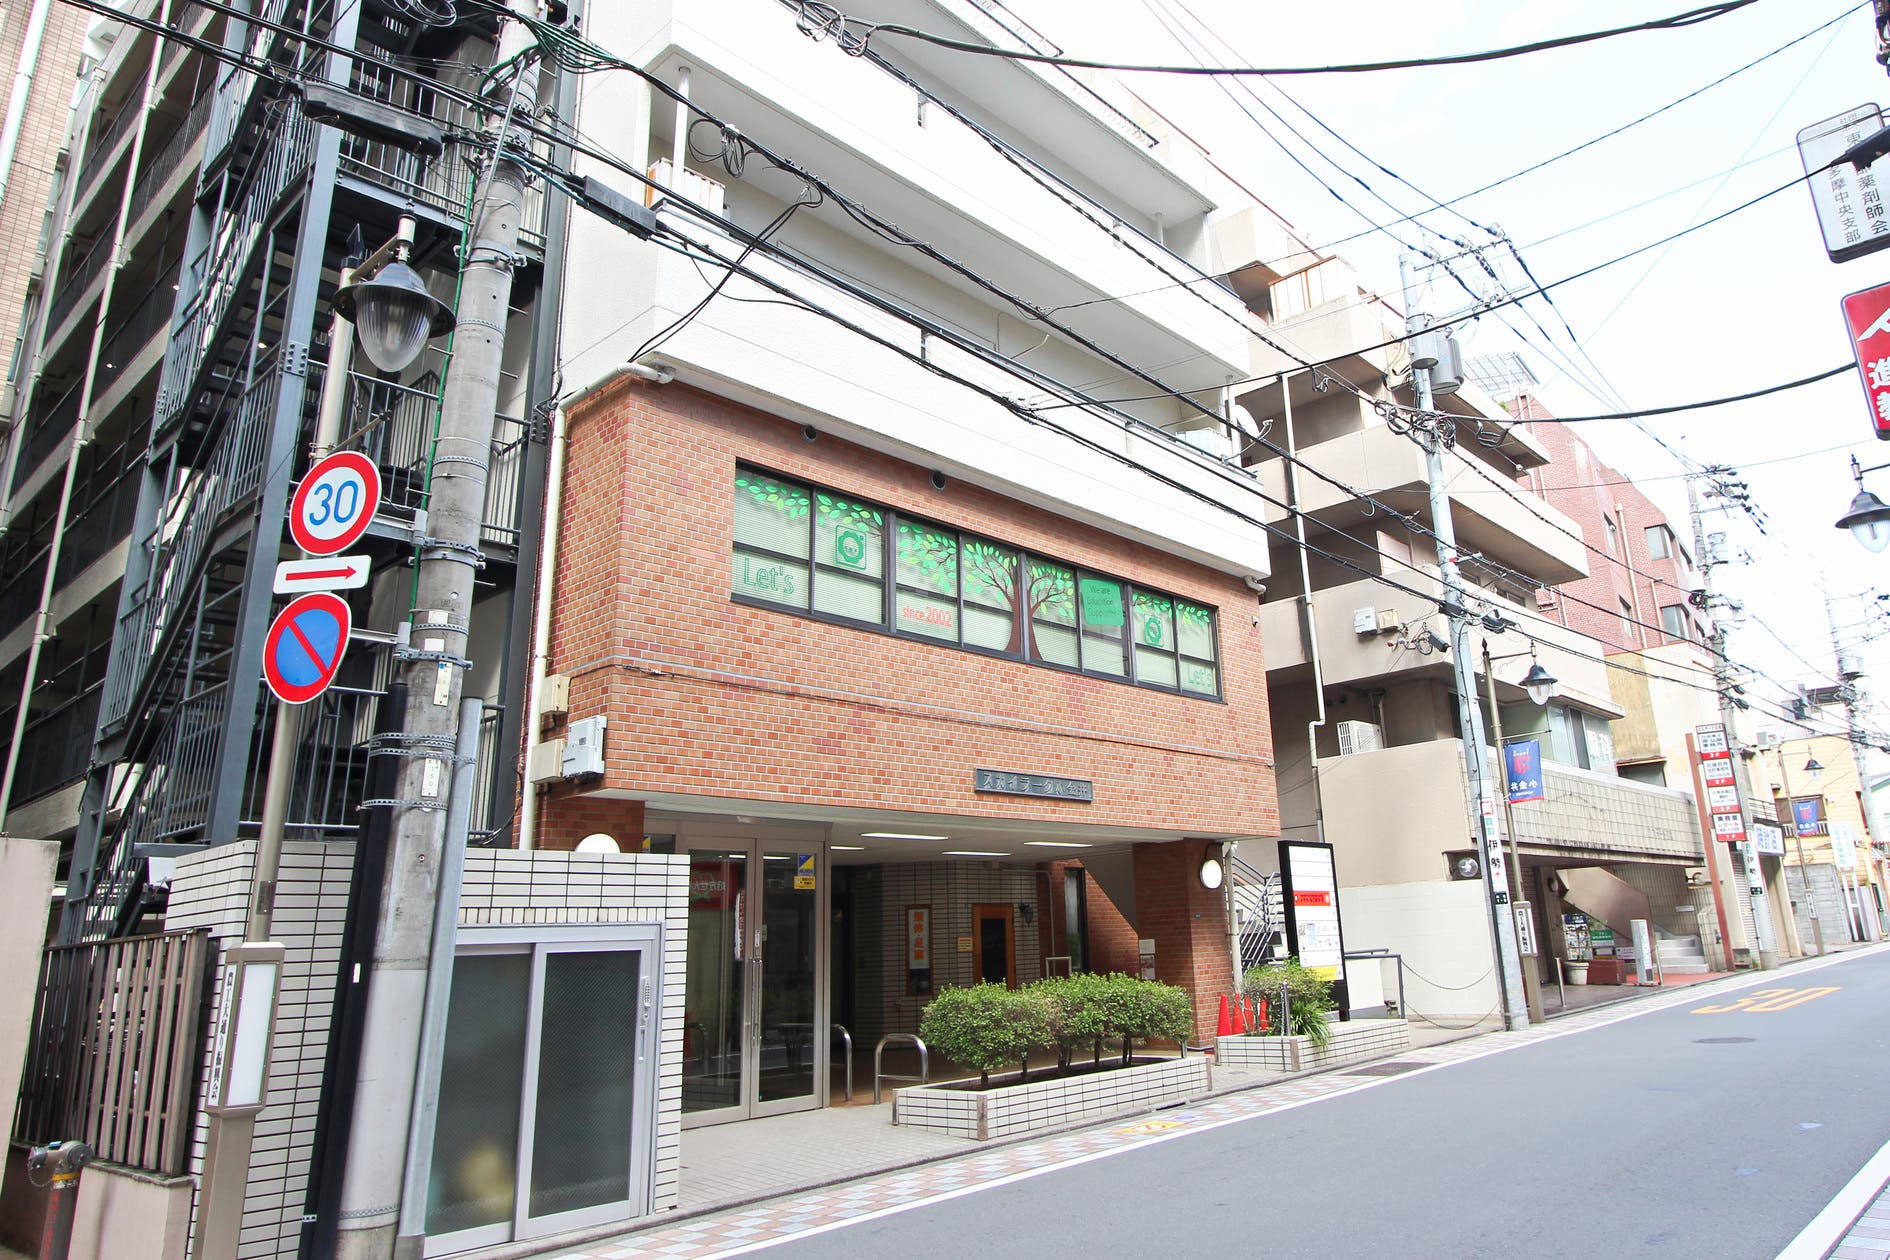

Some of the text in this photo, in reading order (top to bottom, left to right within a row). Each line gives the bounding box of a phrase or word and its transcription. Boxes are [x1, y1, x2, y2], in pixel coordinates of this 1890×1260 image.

[1847, 131, 1888, 235] 東薬剤師会
[309, 480, 359, 526] 30
[743, 558, 794, 594] Let's
[902, 606, 924, 620] since
